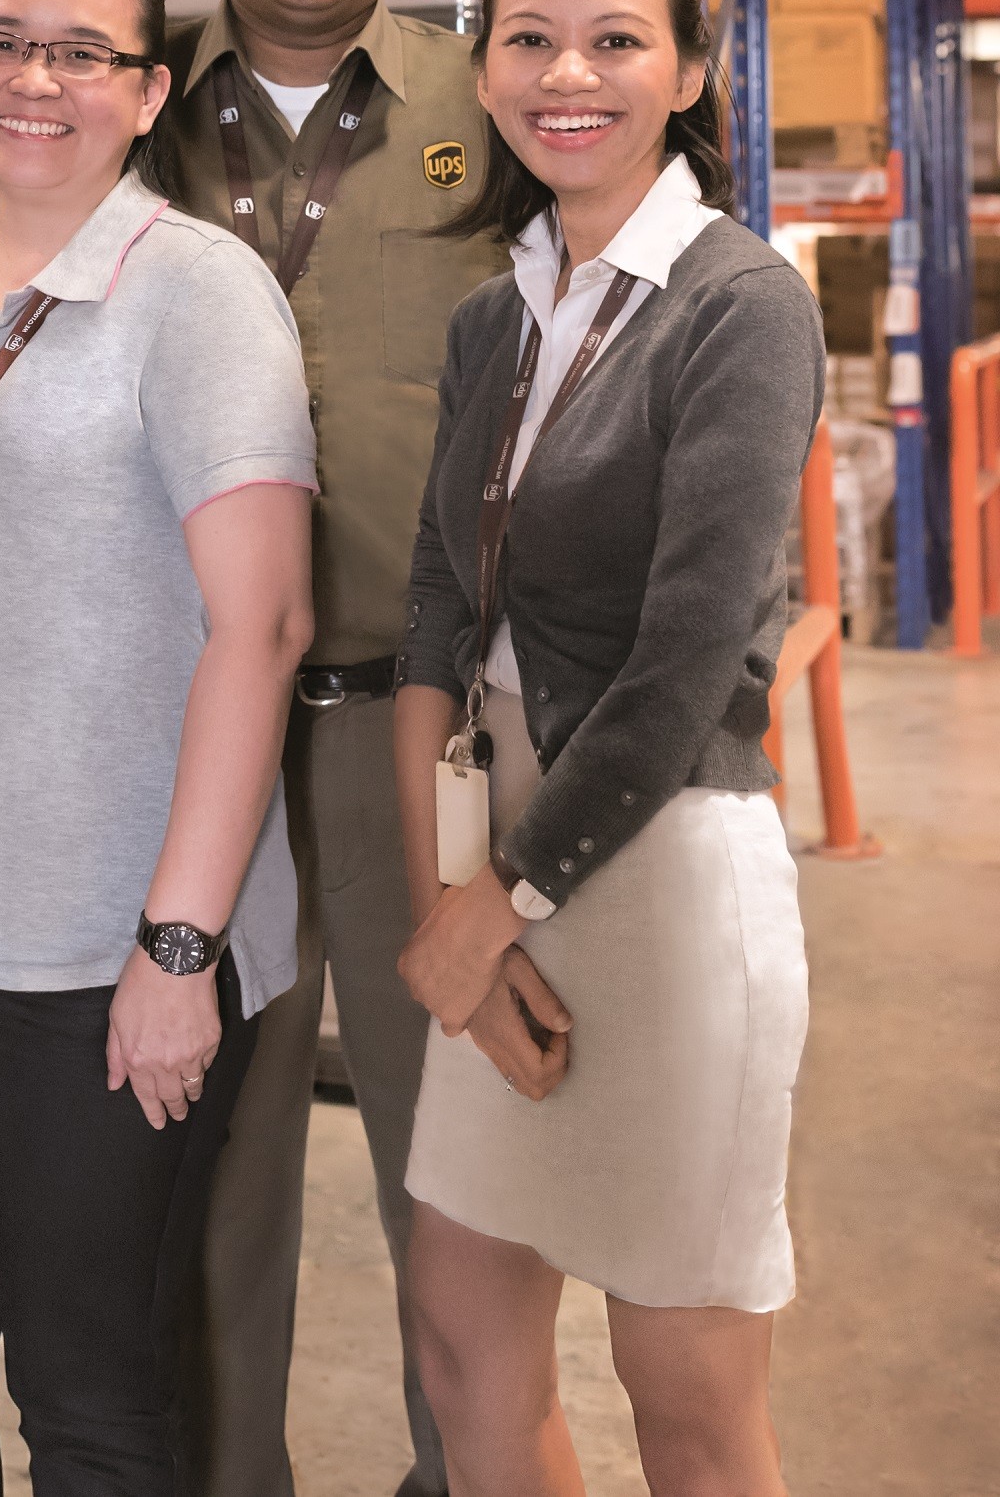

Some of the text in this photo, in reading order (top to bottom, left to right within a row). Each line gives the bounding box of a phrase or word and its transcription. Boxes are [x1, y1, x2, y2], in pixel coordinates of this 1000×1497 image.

[427, 156, 463, 181] ups
[22, 296, 53, 333] WE LOGISTICS
[9, 336, 21, 350] ups
[586, 333, 599, 350] ups
[489, 485, 499, 500] ups
